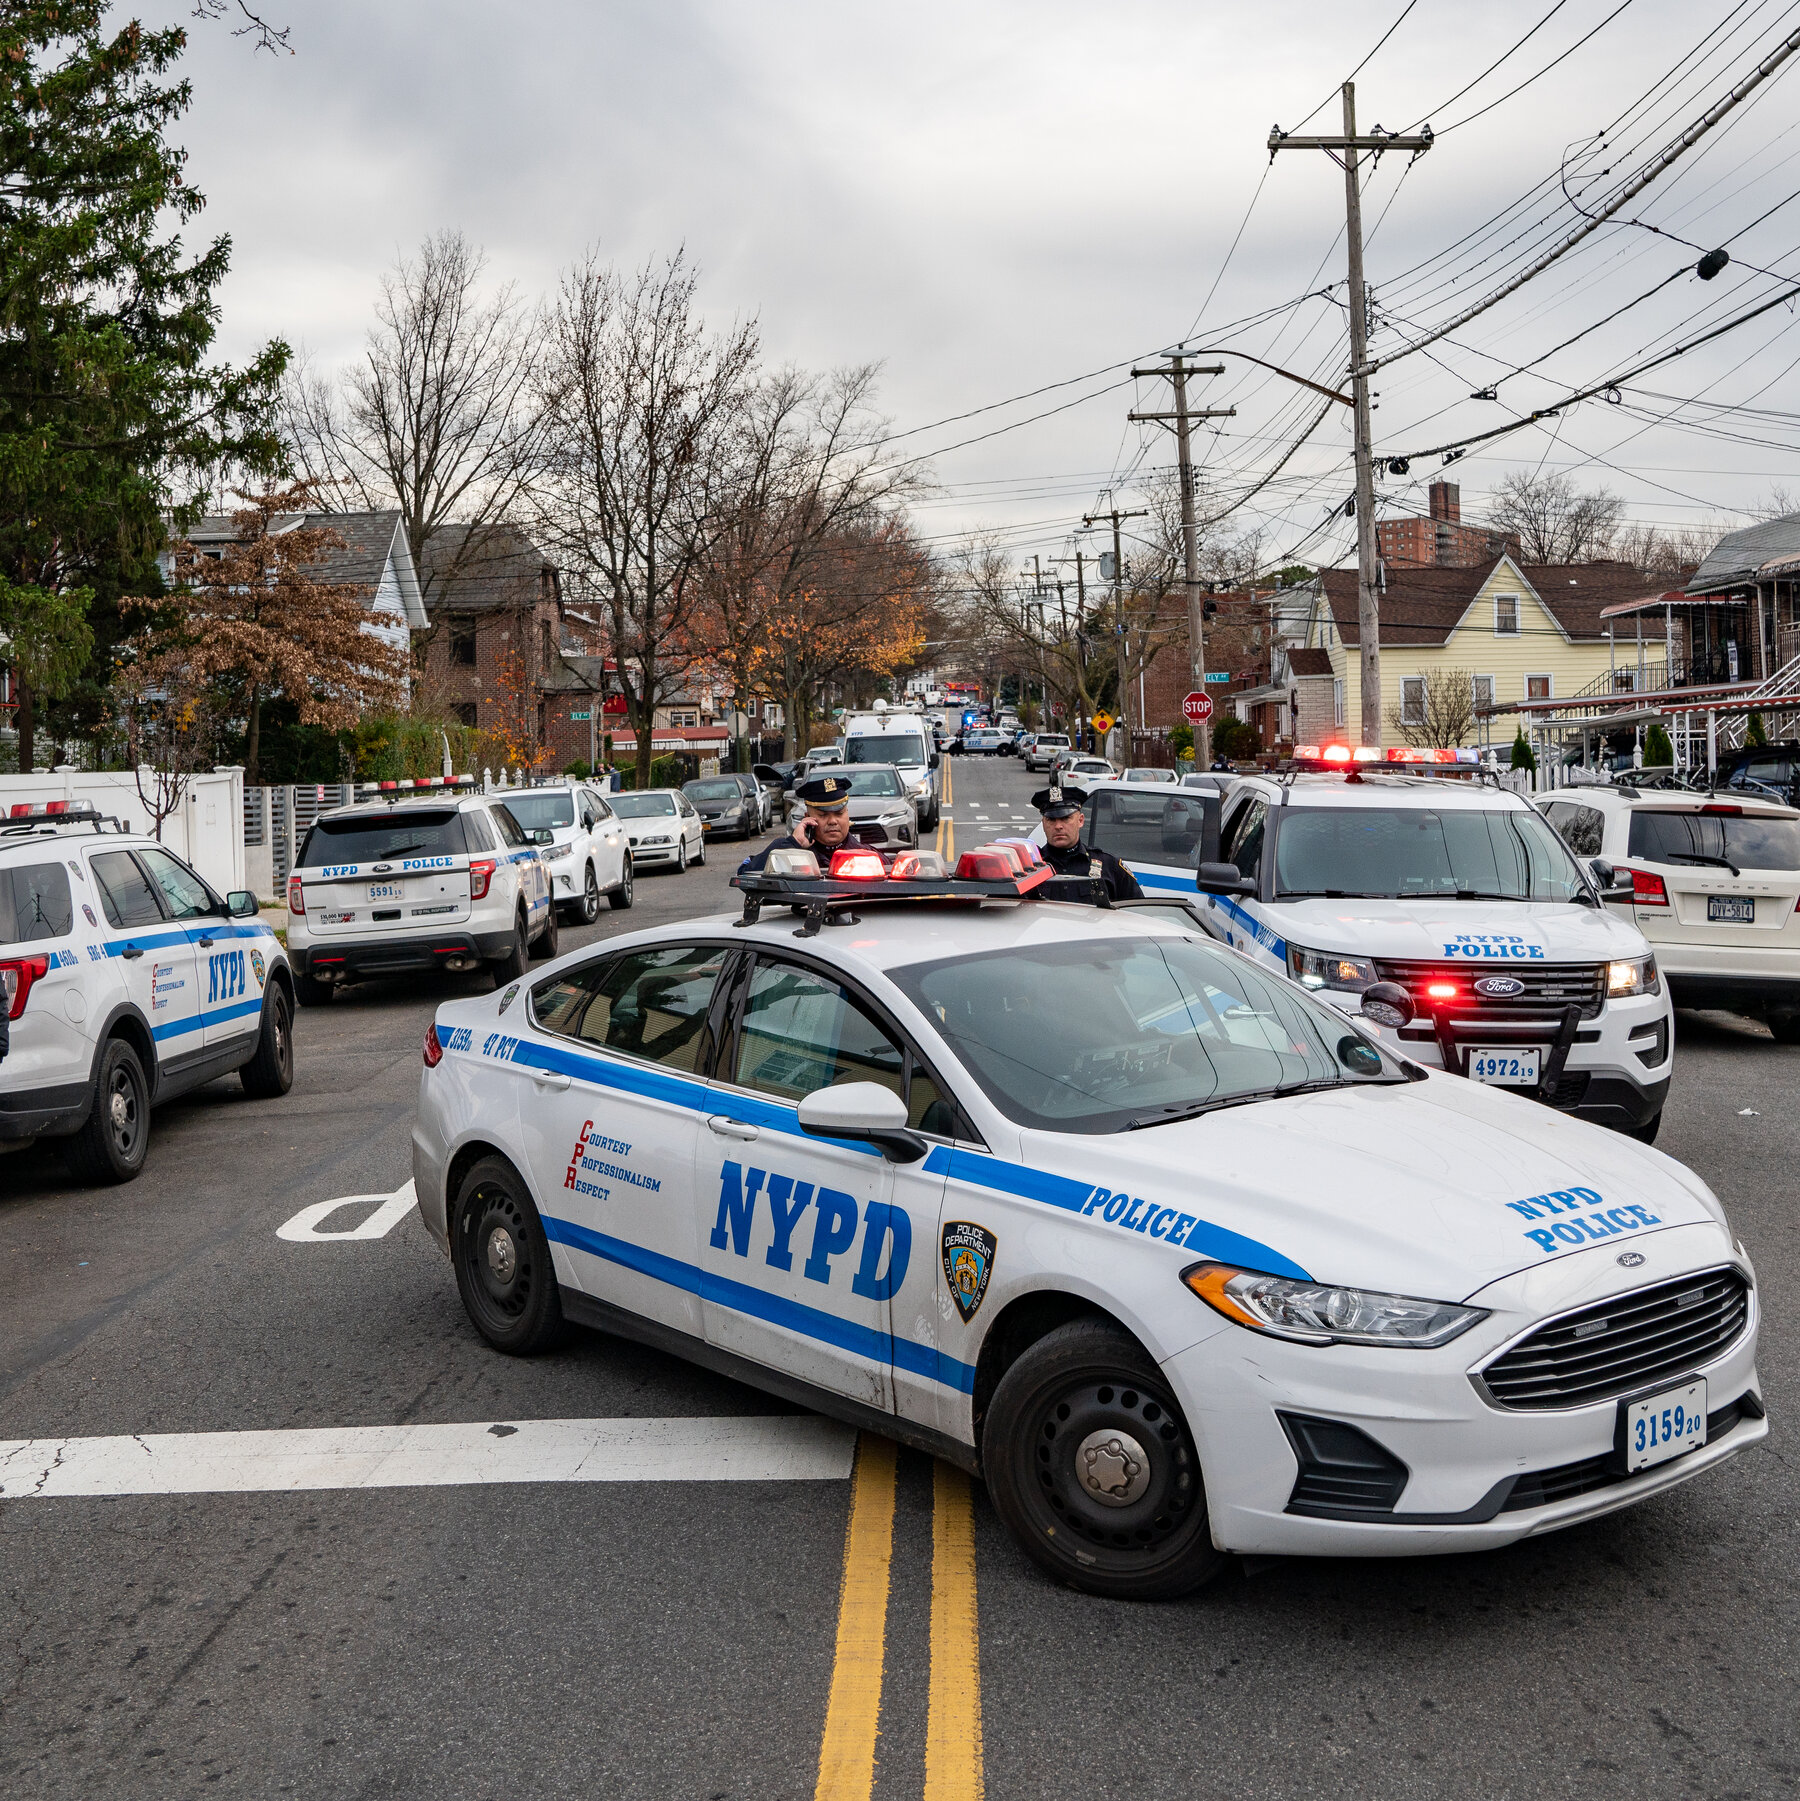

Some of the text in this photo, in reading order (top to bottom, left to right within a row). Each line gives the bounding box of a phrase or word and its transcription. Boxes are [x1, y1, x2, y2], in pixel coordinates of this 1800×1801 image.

[1185, 701, 1211, 713] STOP
[322, 865, 358, 877] NYPD
[403, 857, 453, 870] POLICE
[1701, 883, 1769, 891] DODGE
[1256, 925, 1278, 952] POLICE
[1443, 944, 1545, 959] POLICE
[1454, 935, 1524, 943] NYPD
[208, 949, 246, 1004] NYPD
[482, 1032, 500, 1056] 47
[493, 1035, 519, 1060] PCT
[580, 1119, 632, 1156] COURTESY
[571, 1142, 661, 1193] PROFESSIONALISM
[563, 1166, 611, 1201] RESPECT
[1082, 1186, 1198, 1246] POLICE
[1504, 1186, 1604, 1221] NYPD
[709, 1159, 912, 1302] NYPD
[957, 1224, 985, 1241] POLICE
[1522, 1204, 1663, 1253] POLICE
[944, 1235, 992, 1260] DEPARTMENT
[944, 1258, 954, 1282] CITY
[951, 1286, 960, 1300] OF
[971, 1266, 990, 1311] NEW YORK
